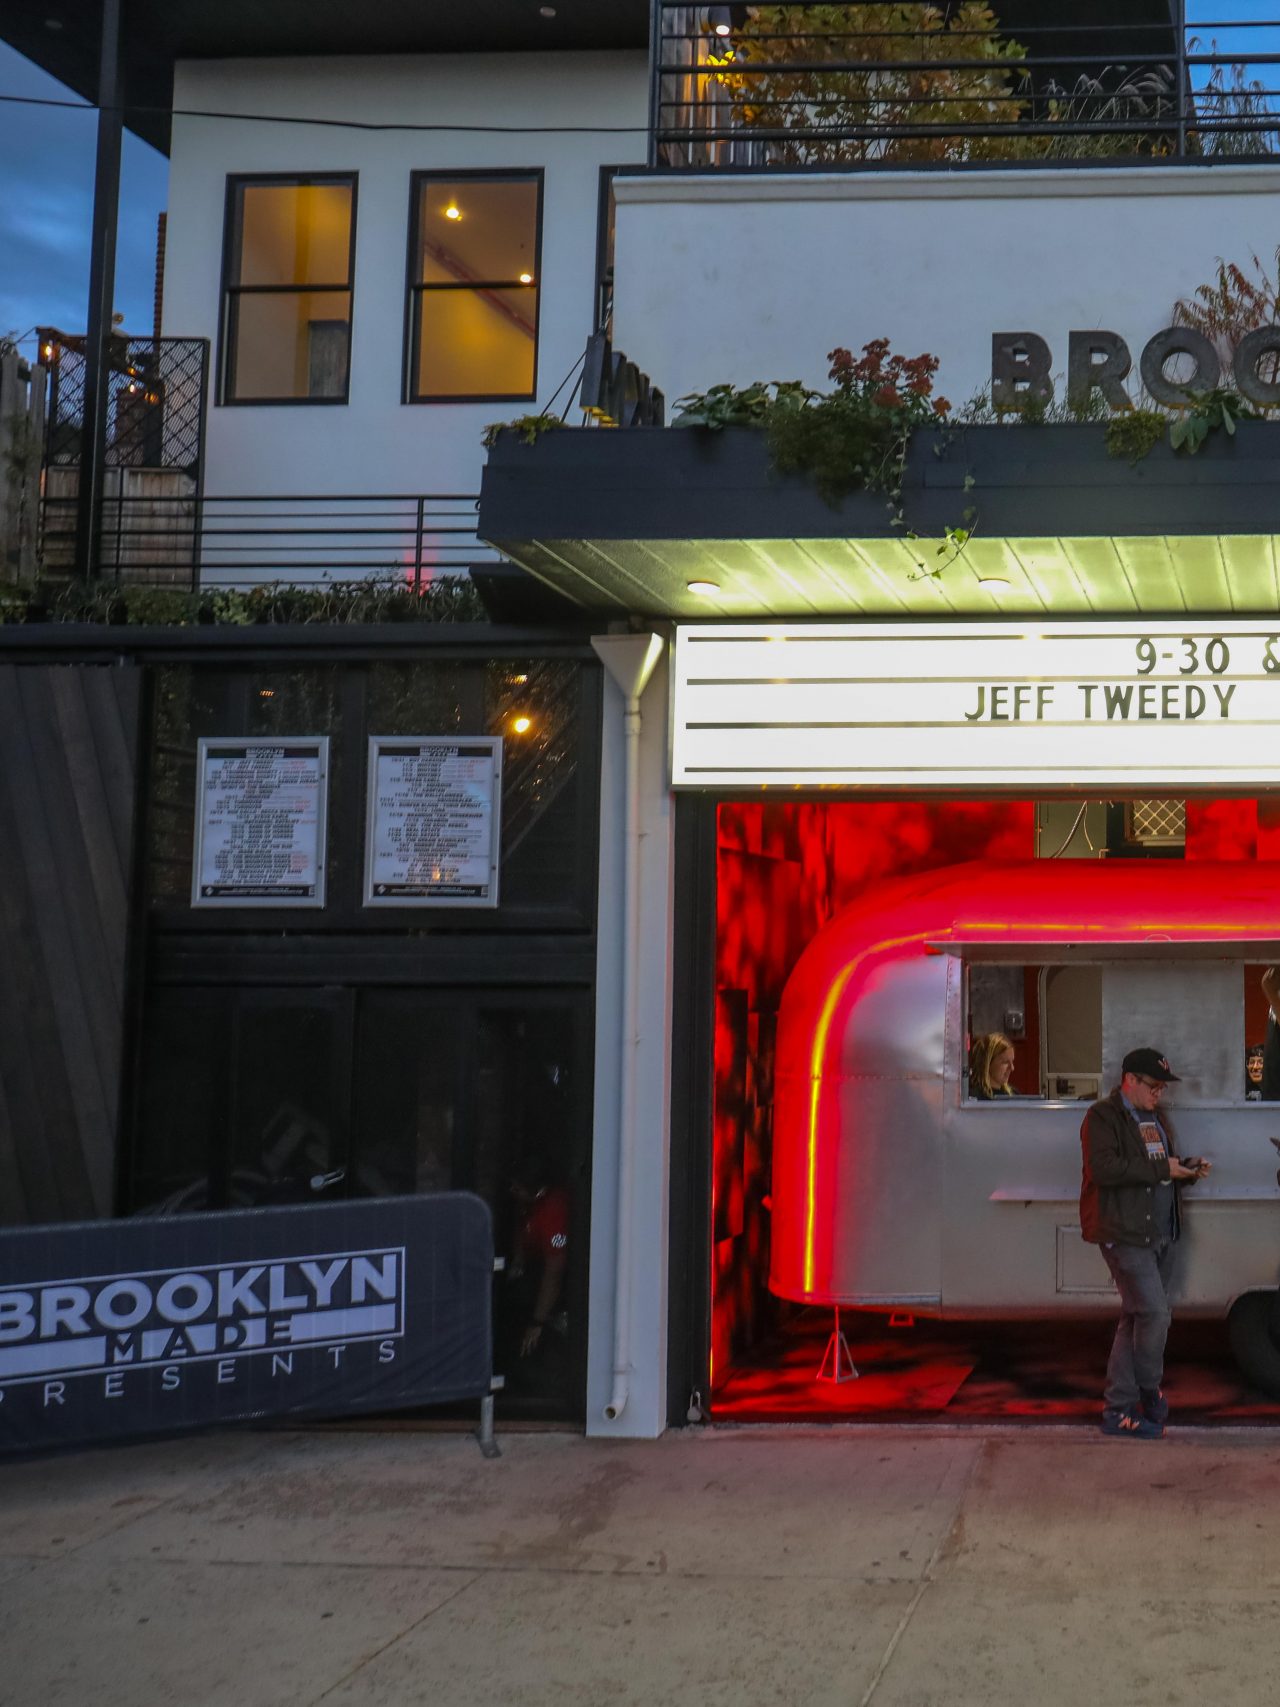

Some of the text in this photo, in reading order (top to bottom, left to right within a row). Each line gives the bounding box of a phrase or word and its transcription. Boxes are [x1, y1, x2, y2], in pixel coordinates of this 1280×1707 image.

[1135, 637, 1231, 674] 9-30
[964, 685, 1054, 720] JEFF
[1078, 684, 1237, 720] TWEEDY
[0, 1253, 397, 1342] BROOKLYN
[105, 1314, 293, 1364] MADE
[0, 1339, 396, 1407] RESENTS
